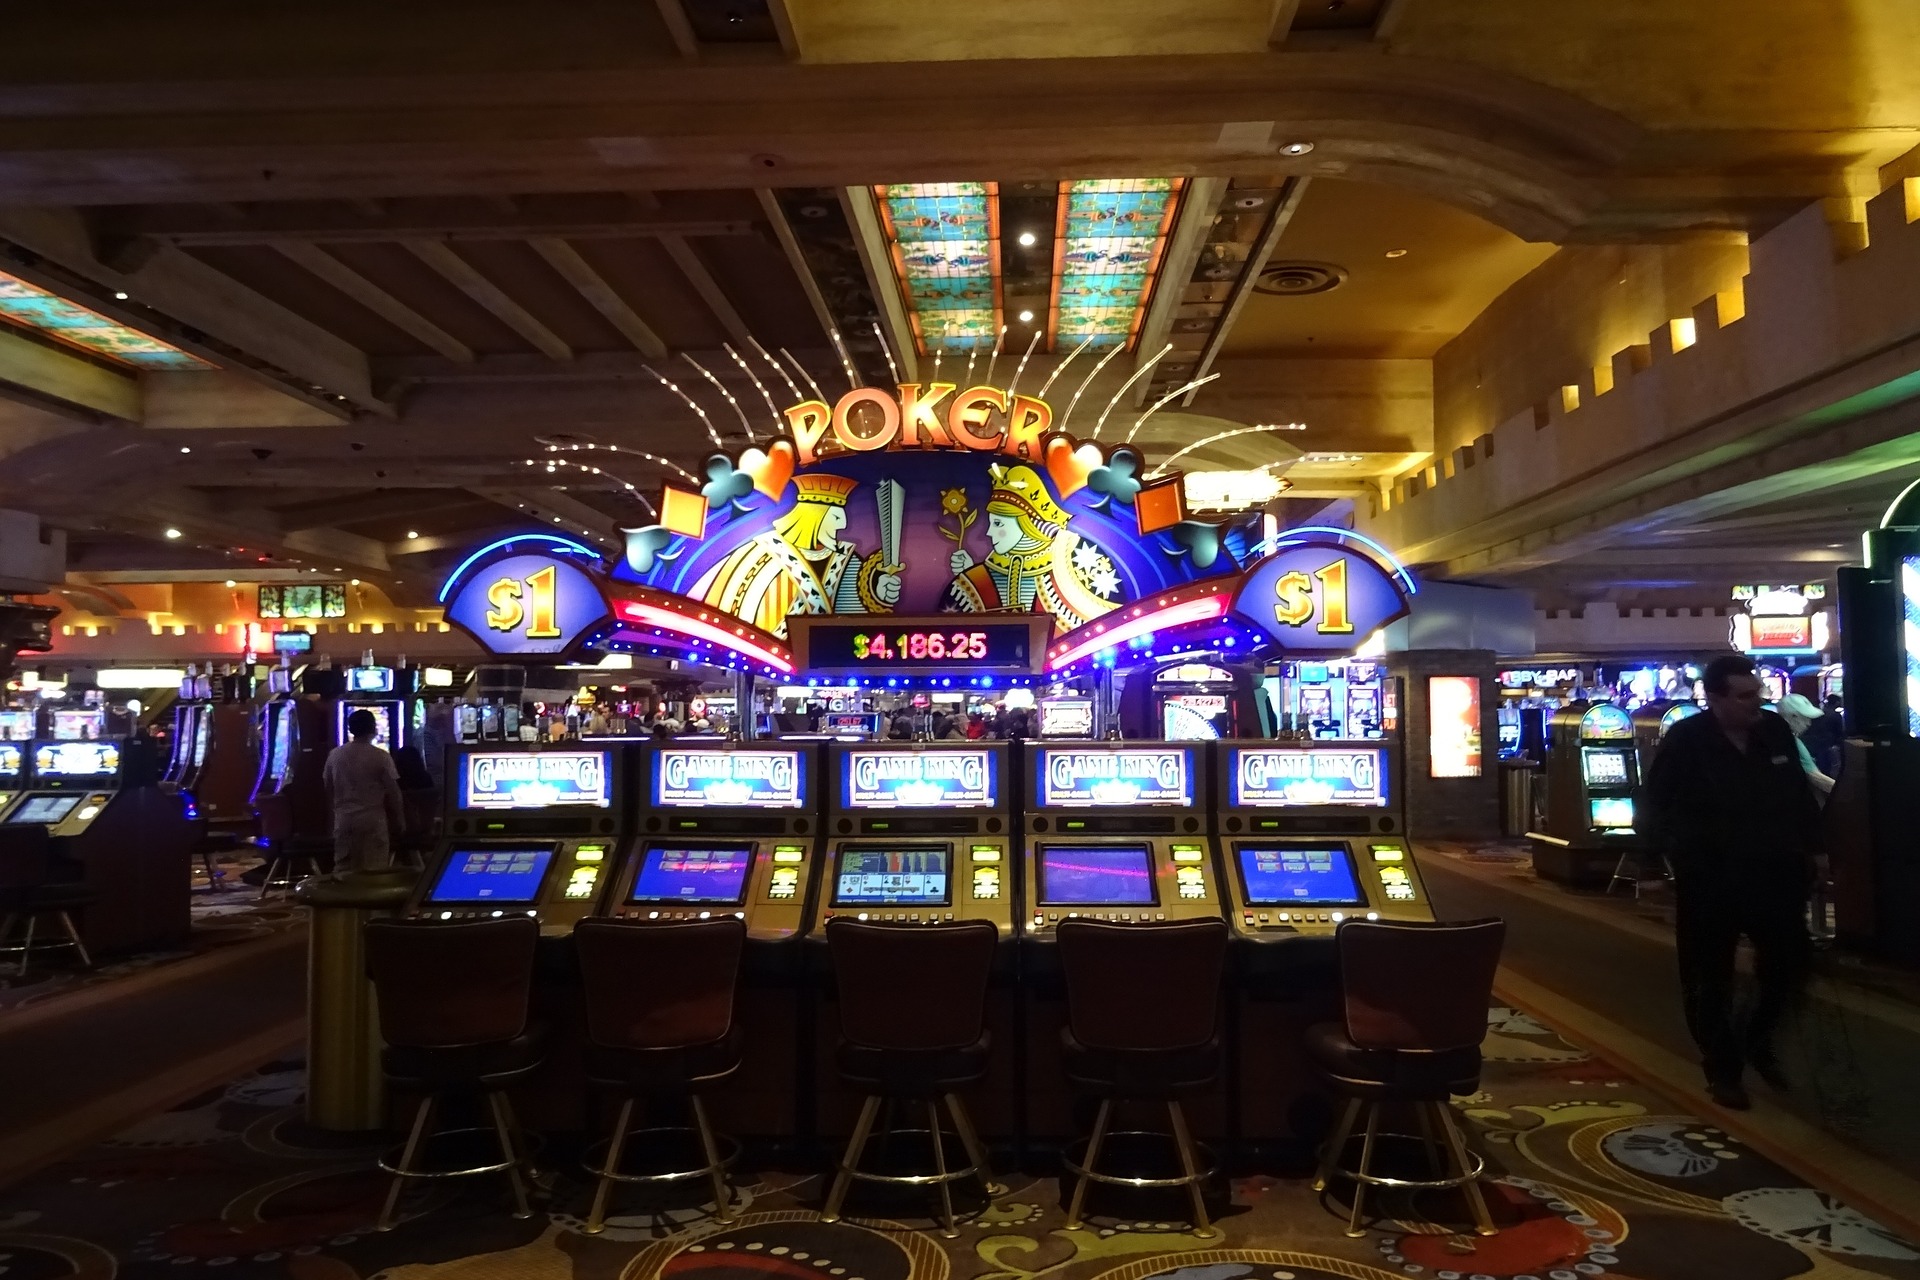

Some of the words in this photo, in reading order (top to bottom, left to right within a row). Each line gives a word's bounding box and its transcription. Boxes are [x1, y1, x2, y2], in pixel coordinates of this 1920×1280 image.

[784, 383, 1053, 467] POKER
[486, 565, 561, 640] $1
[1274, 557, 1355, 635] $1
